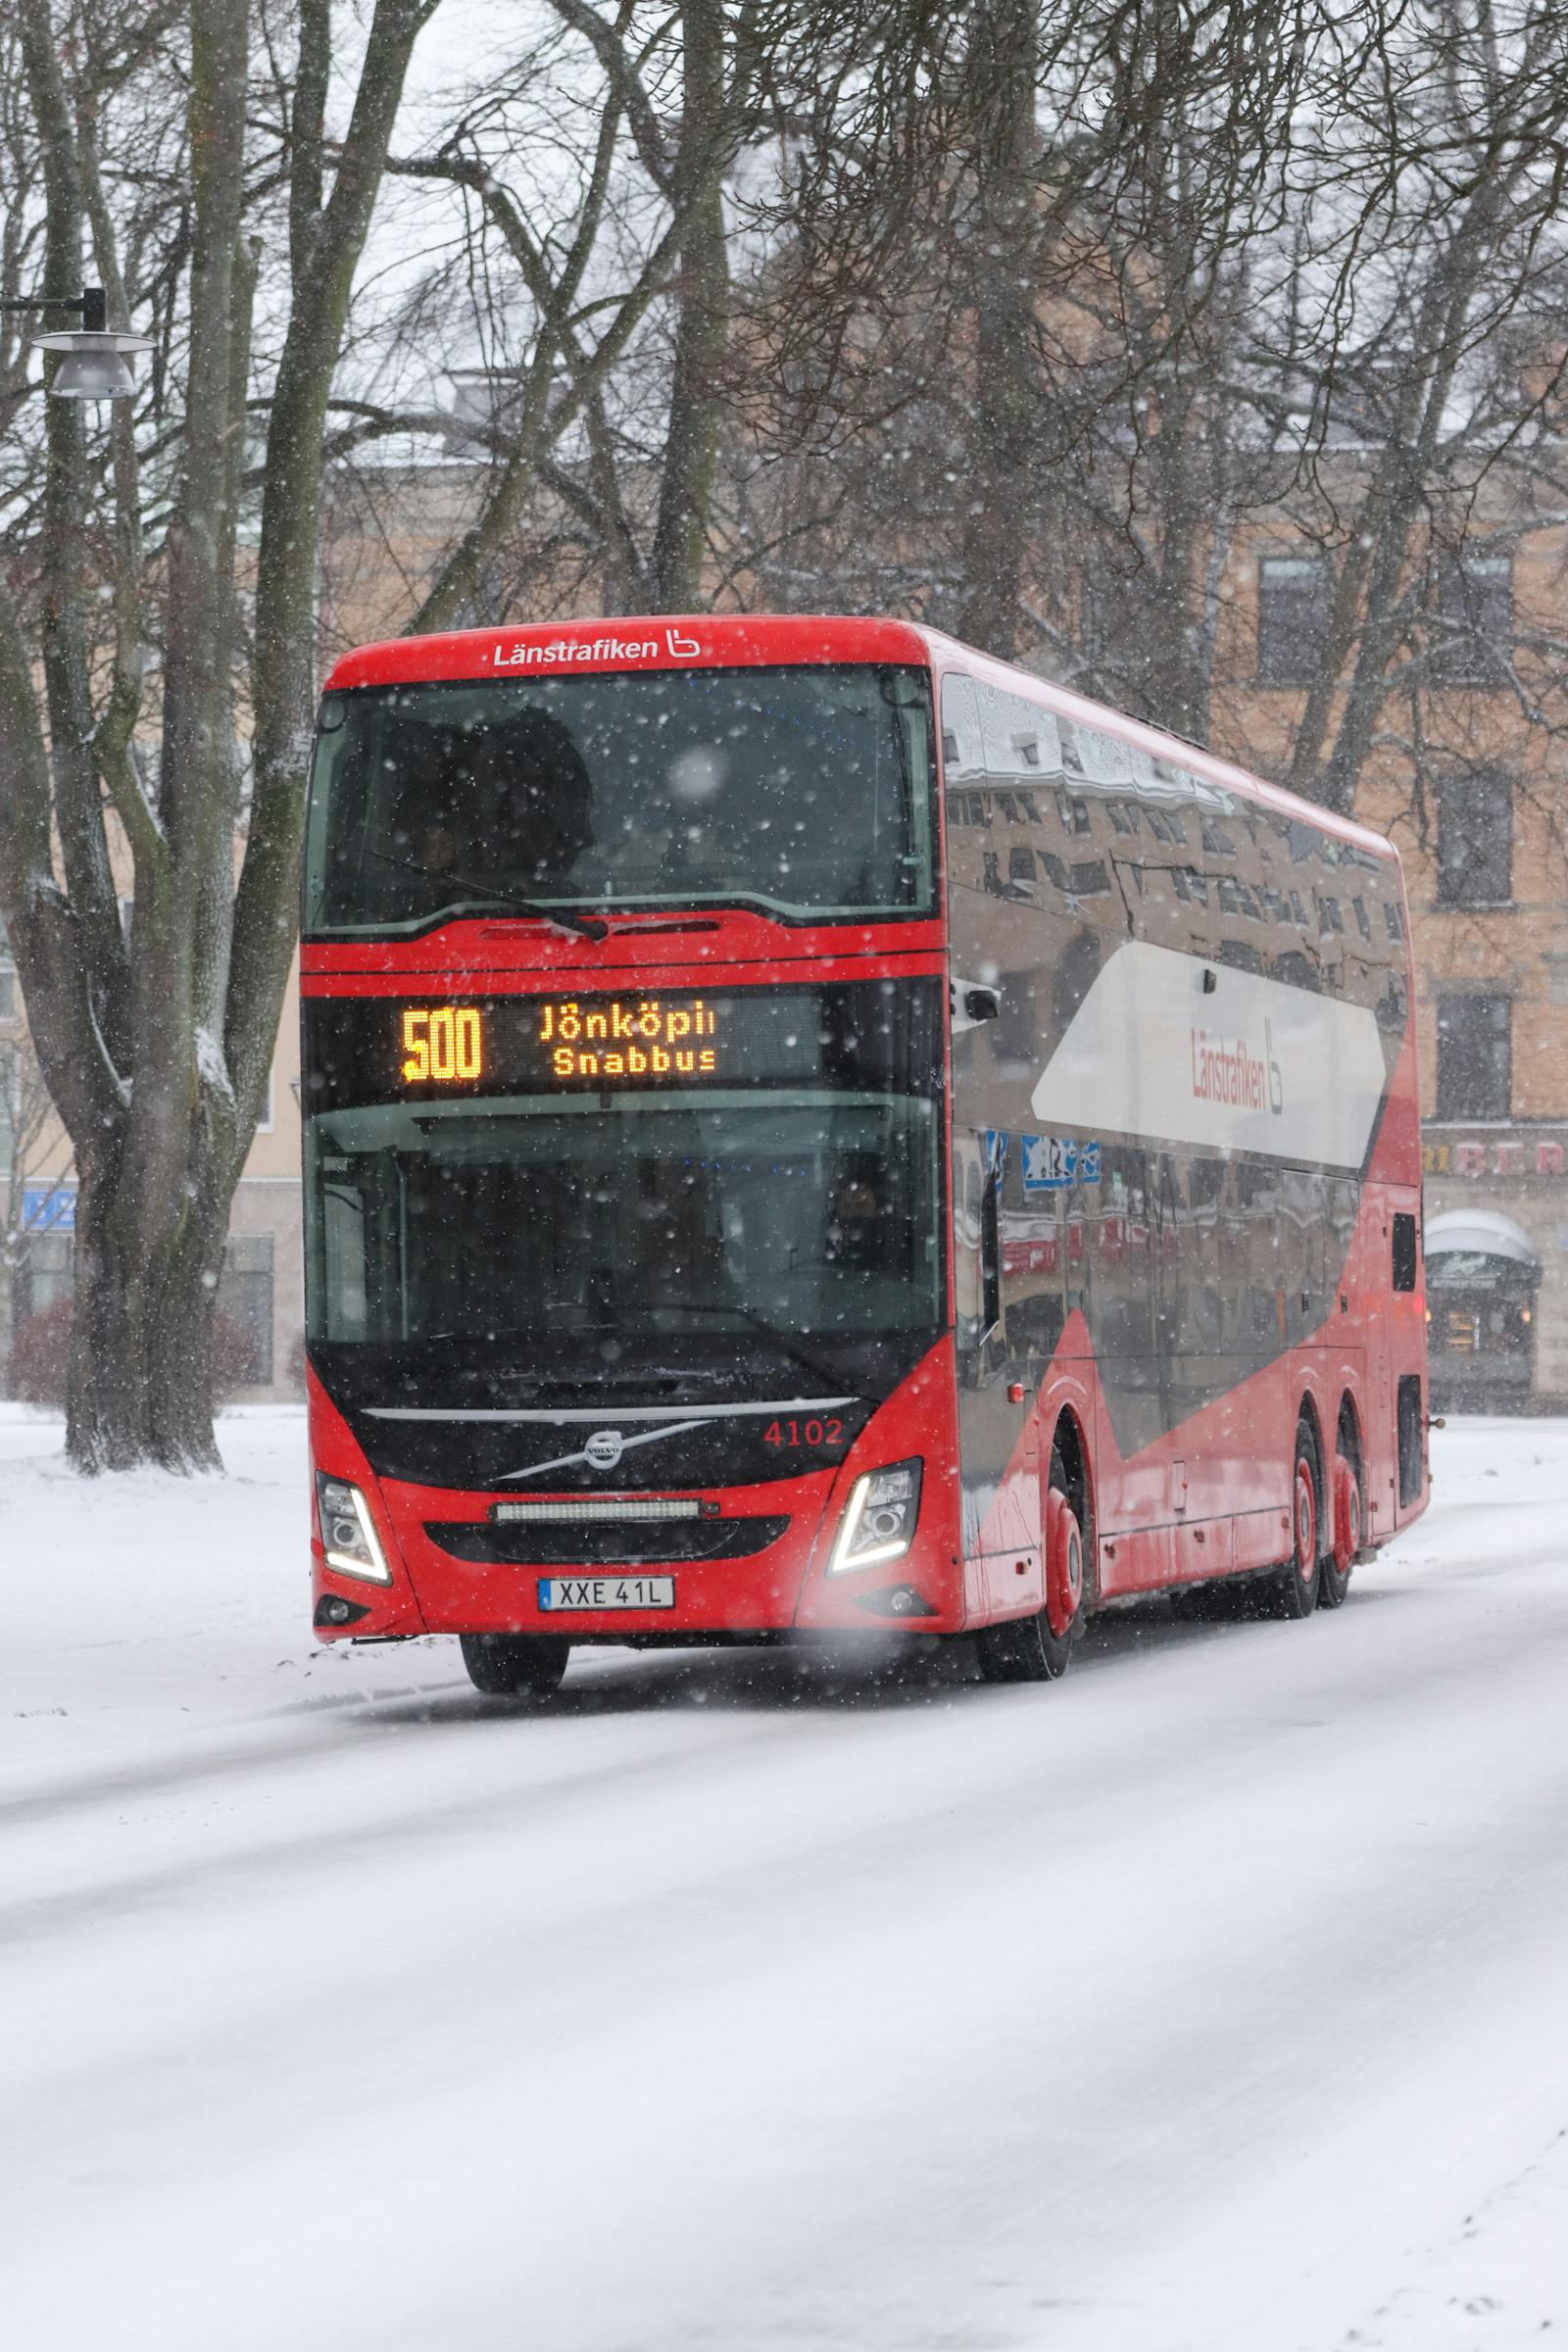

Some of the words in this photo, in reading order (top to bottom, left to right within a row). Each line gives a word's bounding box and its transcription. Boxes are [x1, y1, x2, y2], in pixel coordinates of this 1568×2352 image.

[493, 638, 659, 666] Länstrafiken
[540, 1000, 714, 1043] Jönköpi
[402, 1006, 481, 1080] 500
[553, 1045, 715, 1075] Snabbus
[1191, 1027, 1266, 1110] Länstrafiken
[762, 1417, 843, 1447] 4102
[560, 1582, 606, 1605] XXE
[614, 1581, 662, 1604] 41L
